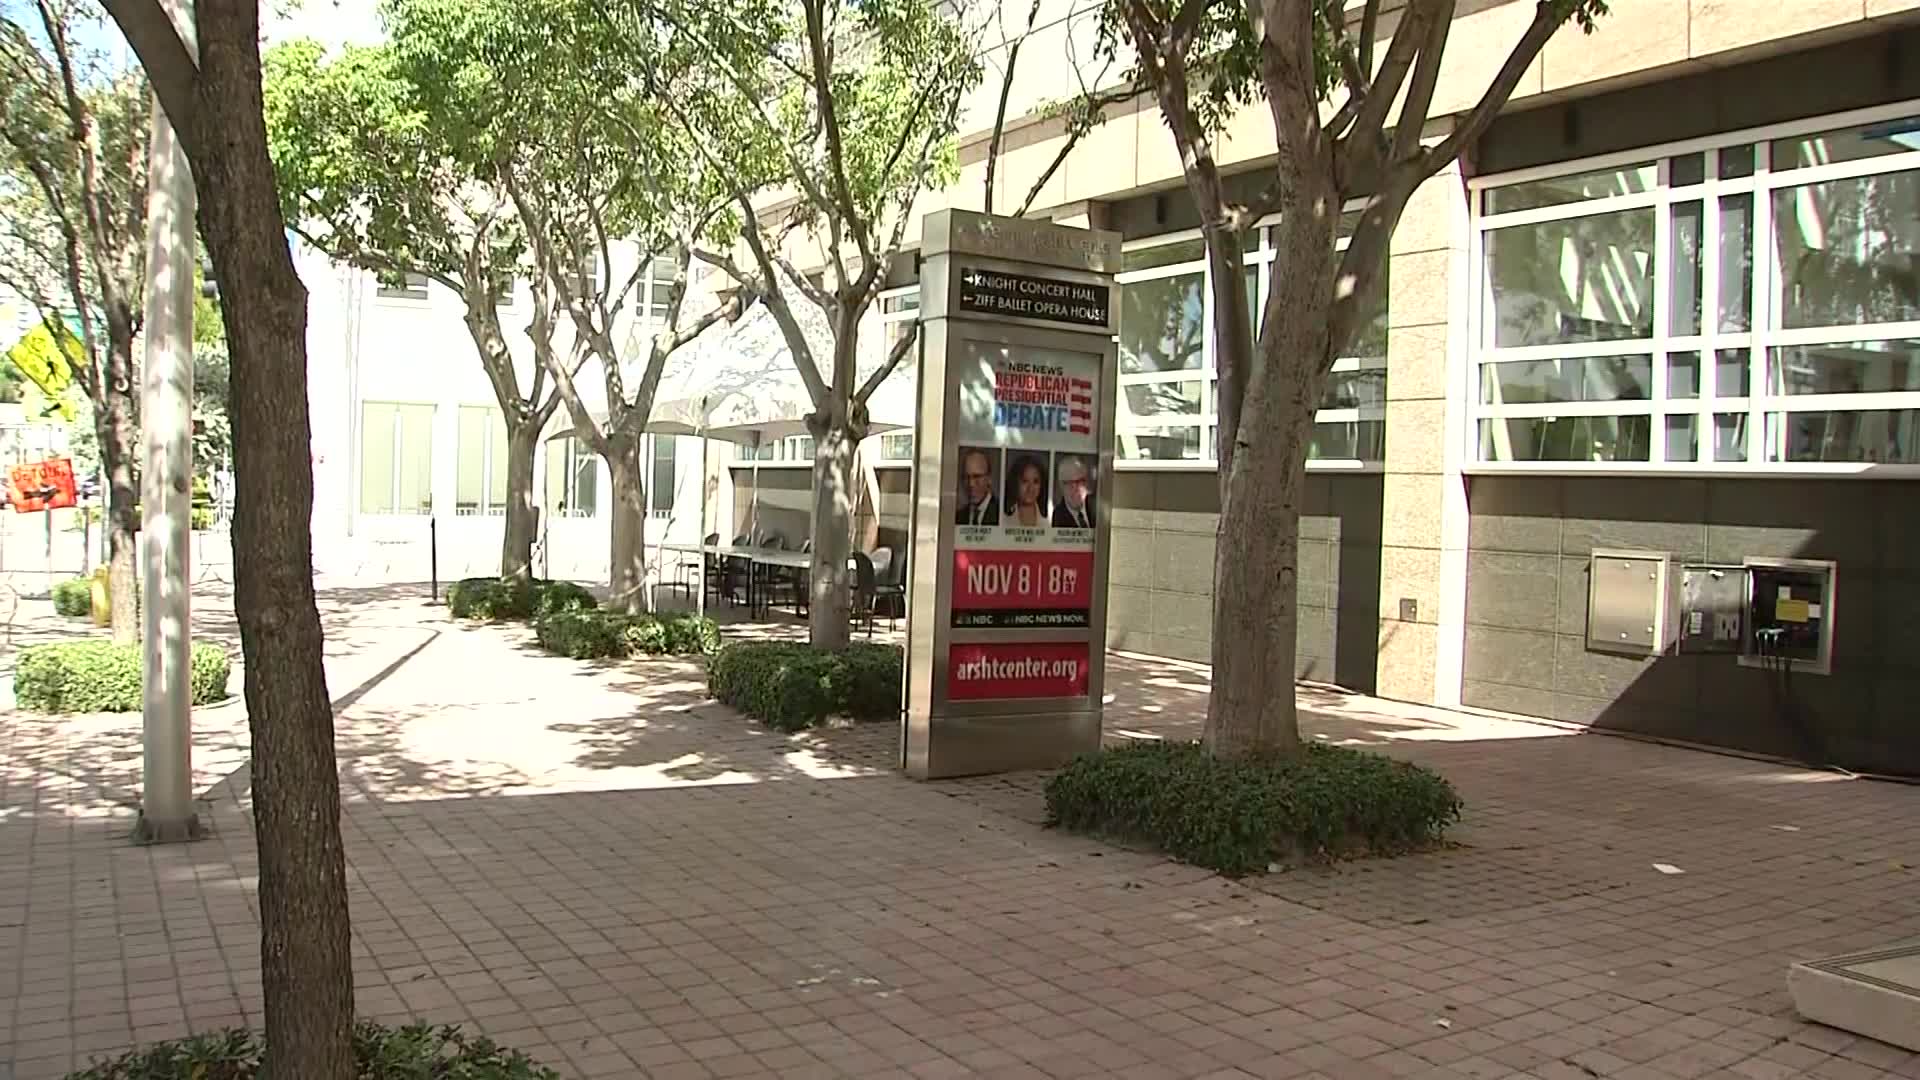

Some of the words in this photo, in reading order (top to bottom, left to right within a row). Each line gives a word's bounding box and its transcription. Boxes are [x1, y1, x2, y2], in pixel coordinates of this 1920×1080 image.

[974, 274, 1018, 290] KNIGHT
[1019, 277, 1071, 297] CONCERT
[1072, 286, 1096, 301] HALL
[974, 294, 996, 307] ZIFF
[998, 297, 1033, 313] BALLET
[1034, 301, 1068, 317] OPERA
[1070, 306, 1105, 321] HOUSE
[995, 371, 1070, 393] REPUBLICAN
[1008, 363, 1032, 373] NBC
[1032, 364, 1064, 376] NEWS
[994, 388, 1068, 406] PRESIDENTIAL
[994, 403, 1068, 432] DEBATE
[967, 564, 1013, 595] NOV
[1018, 565, 1031, 595] 8
[1049, 565, 1062, 595] 8
[972, 615, 993, 625] NBC
[1015, 615, 1034, 624] NBC
[1035, 614, 1062, 624] NEWS
[956, 655, 1077, 681] arshtcenter.org
